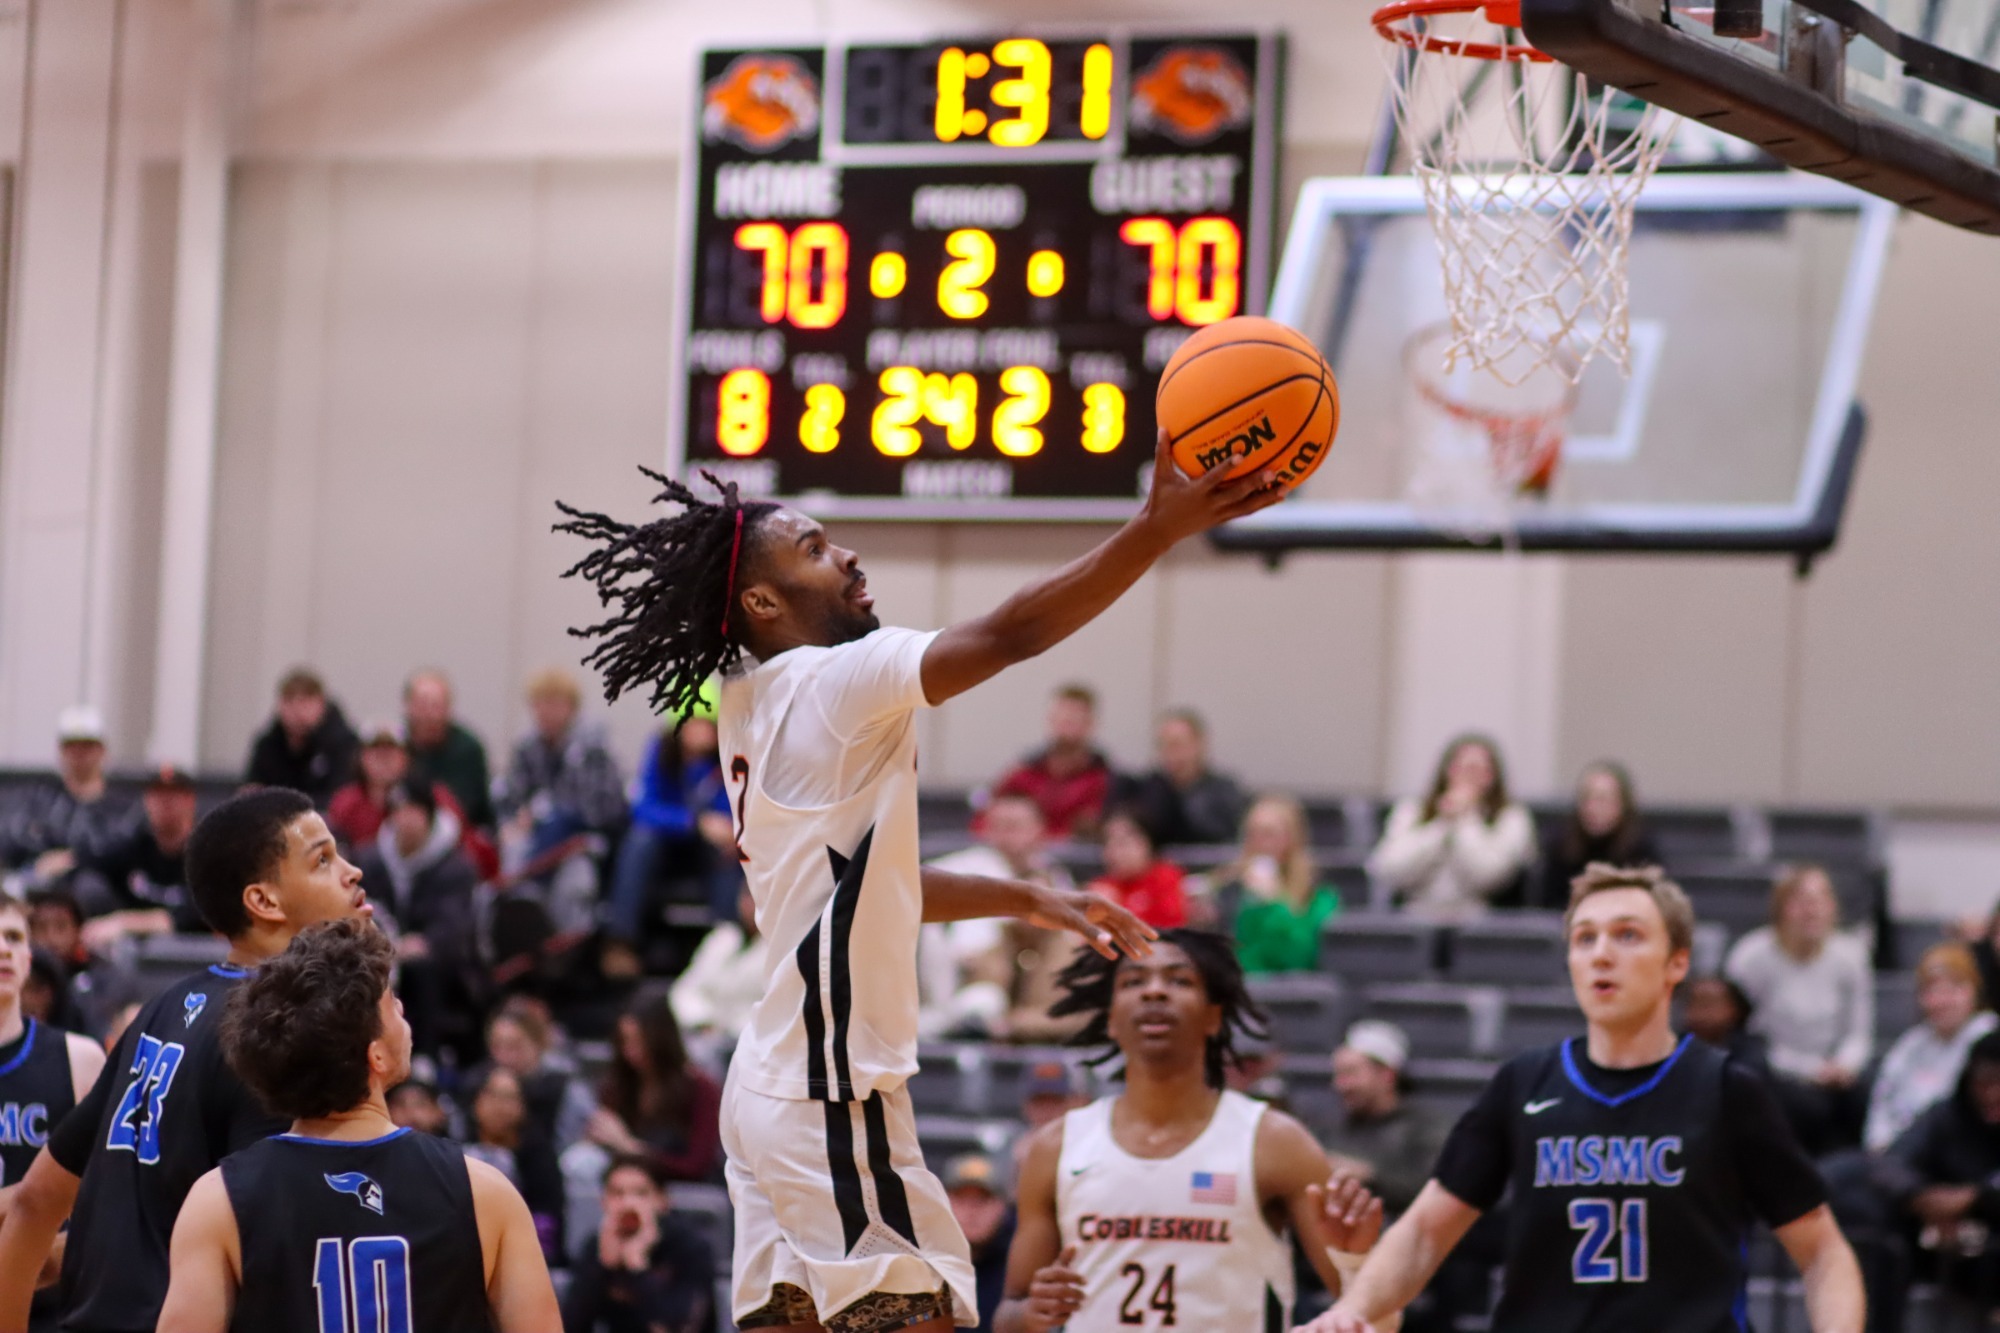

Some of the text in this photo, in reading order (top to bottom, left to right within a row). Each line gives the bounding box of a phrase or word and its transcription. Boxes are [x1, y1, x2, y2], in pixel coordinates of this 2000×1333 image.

[935, 39, 1112, 147] 1:31
[714, 161, 842, 219] HOME
[1090, 154, 1241, 215] GUEST
[734, 222, 849, 329] 70
[937, 228, 996, 319] 2
[1119, 217, 1241, 326] 70
[716, 367, 771, 455] 8
[799, 383, 845, 453] 2
[871, 366, 978, 456] 24
[991, 365, 1051, 456] 2
[1196, 416, 1277, 471] NCAA
[106, 1033, 184, 1165] 23
[1533, 1136, 1686, 1187] MSMC
[1078, 1214, 1231, 1243] COBLESKILL
[1567, 1198, 1648, 1283] 21
[312, 1236, 413, 1333] 10
[1119, 1262, 1176, 1326] 24
